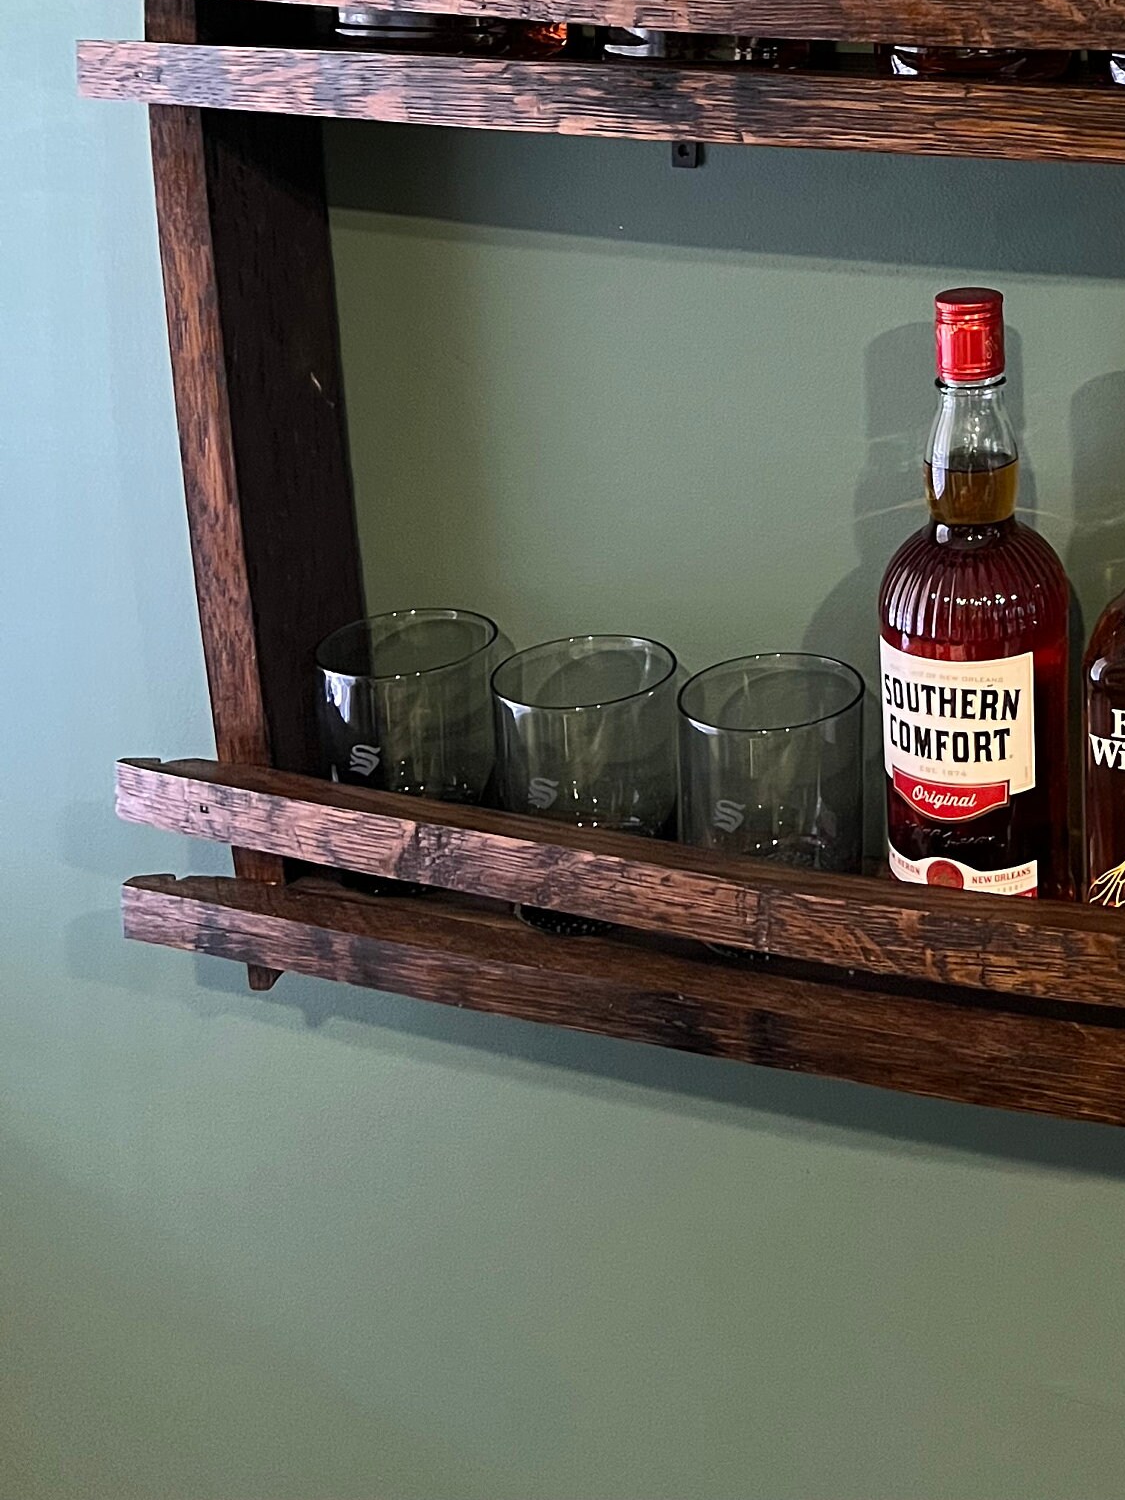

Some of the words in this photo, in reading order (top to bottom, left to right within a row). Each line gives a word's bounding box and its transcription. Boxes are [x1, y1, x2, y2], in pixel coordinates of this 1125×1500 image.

[884, 673, 1022, 721] SOUTHERN
[889, 713, 1011, 763] COMFORT
[911, 784, 977, 809] Original
[971, 875, 992, 885] NEW
[994, 867, 1032, 883] ORLEANS
